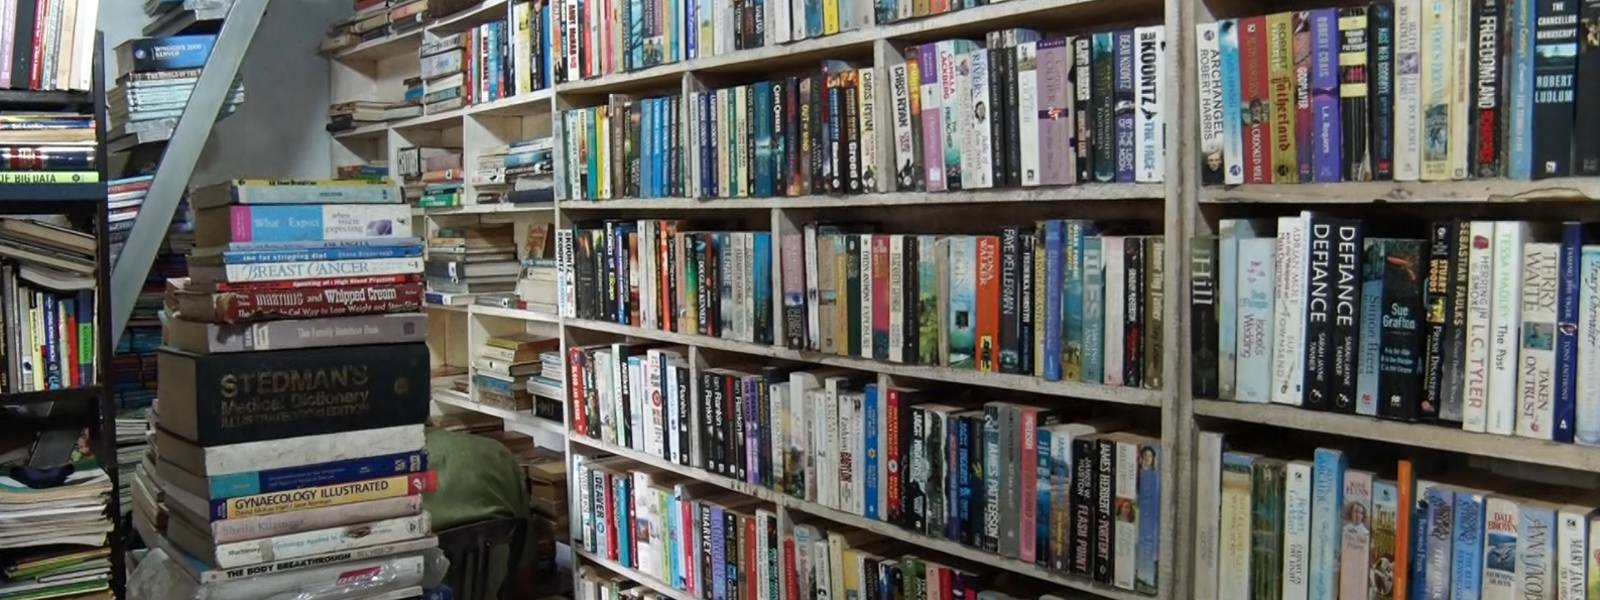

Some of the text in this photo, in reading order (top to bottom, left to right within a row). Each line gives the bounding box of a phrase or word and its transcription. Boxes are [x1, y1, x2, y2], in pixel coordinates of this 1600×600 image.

[1553, 2, 1564, 11] THE
[1119, 34, 1131, 89] DEAN KOONTZ
[1140, 41, 1156, 105] KOONTZ
[1478, 16, 1496, 108] FREEDOMLAND
[1537, 75, 1573, 88] ROBERT
[863, 72, 873, 132] CHRIS RYAN
[894, 66, 908, 127] CHRIS RYAN
[1200, 49, 1213, 140] ROBERT HARRIS
[1211, 49, 1222, 138] ARCHANGEL
[1271, 76, 1291, 151] Fatherland
[1535, 90, 1573, 103] LUDLUM
[848, 142, 857, 179] Greed
[1144, 122, 1154, 171] THE FACE
[15, 174, 30, 182] BIG
[33, 174, 56, 182] DATA
[254, 217, 320, 229] What Expect
[245, 262, 368, 279] BREAST CANCER
[979, 240, 988, 286] WALKER
[1003, 229, 1015, 314] FAYE KELLERMAN
[1192, 257, 1213, 305] Hill
[1311, 223, 1330, 322] DEFIANCE
[1337, 226, 1356, 326] DEFIANCE
[1429, 259, 1439, 293] WOODS
[1439, 259, 1448, 293] STUART
[1453, 222, 1469, 327] SEBASTIAN FAULKS
[1479, 256, 1489, 306] HERRING
[1499, 232, 1512, 319] TESSA HADLEY
[1523, 251, 1542, 313] WAITE
[1540, 252, 1557, 314] TERRY
[1585, 260, 1600, 294] Tracy
[324, 289, 365, 305] Whipped
[368, 287, 396, 301] Cream
[1392, 303, 1408, 315] Sue
[1383, 315, 1415, 329] Grafton
[1496, 324, 1508, 344] The
[1587, 296, 1600, 347] Chevalier
[1277, 312, 1290, 377] TOWNSEND
[1317, 332, 1325, 358] SARAH
[1344, 336, 1352, 362] SARAH
[1468, 324, 1484, 408] L.C. TYLER
[221, 365, 368, 397] STEDMAN'S
[291, 390, 369, 407] Dictionary
[1523, 356, 1537, 419] ON TRUST
[1537, 368, 1550, 411] TAKEN
[714, 392, 722, 426] Rankin
[736, 396, 744, 433] Rankin
[913, 411, 922, 437] JACK
[840, 451, 852, 482] BABYLON
[1099, 443, 1111, 472] JAMES
[235, 480, 389, 511] GYNAECOLOGY ILLUSTRATED
[595, 477, 604, 518] DEAVER
[987, 442, 998, 538] JAMES PATTERSON
[1099, 474, 1111, 517] HERBERT
[703, 513, 711, 554] HARVEY
[1076, 504, 1089, 571] FLASH POINT
[1522, 514, 1548, 559] ANNA
[227, 570, 243, 579] THE
[247, 565, 273, 577] BODY
[277, 553, 351, 570] BREAKTHROUGH
[1569, 539, 1583, 595] MARY JANE
